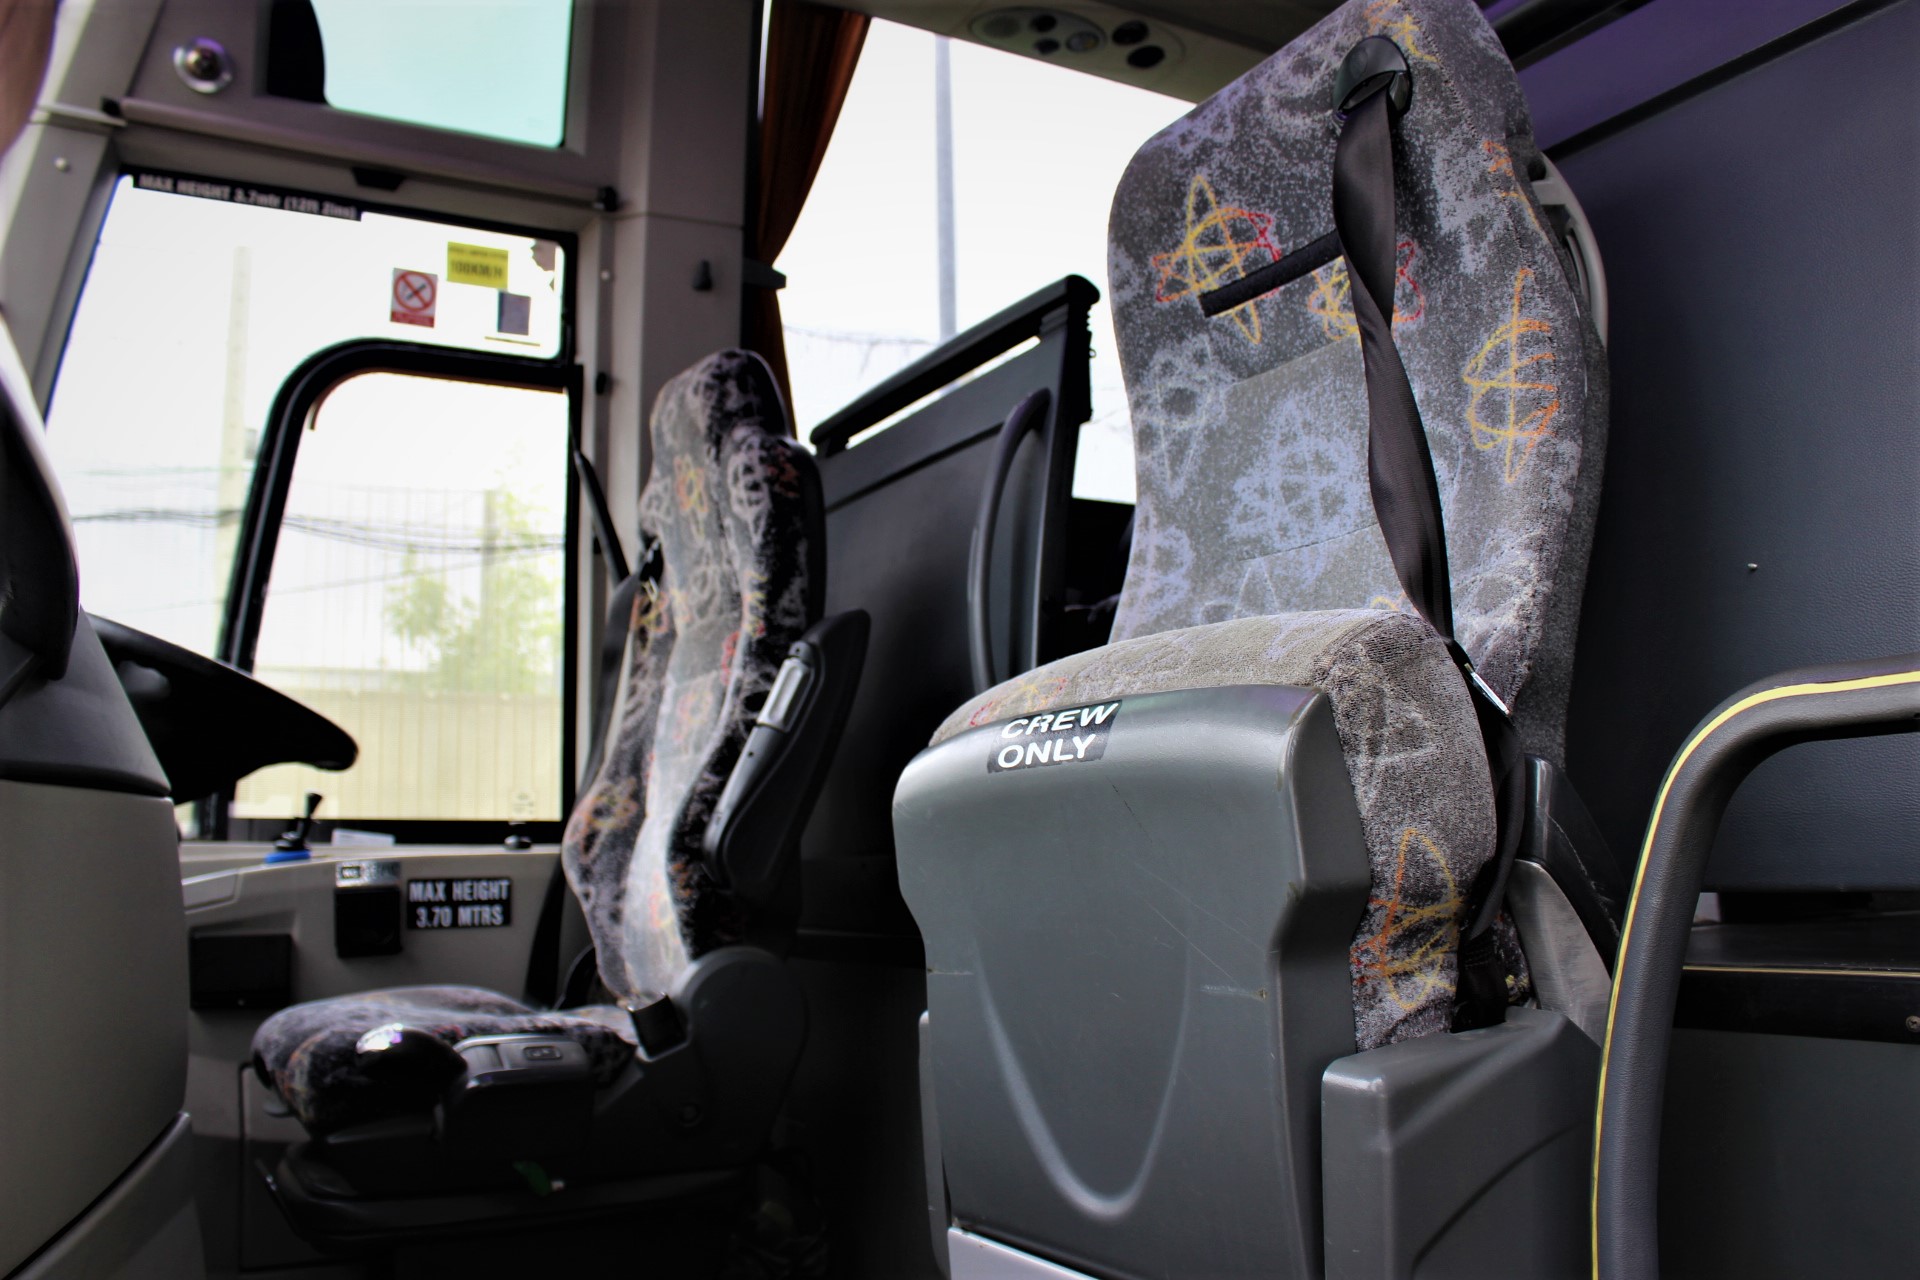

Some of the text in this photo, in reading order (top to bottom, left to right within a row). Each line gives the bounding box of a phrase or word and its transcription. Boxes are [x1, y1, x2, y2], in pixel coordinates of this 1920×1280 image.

[138, 173, 174, 193] MAX
[176, 179, 231, 201] HEIGHT
[1001, 702, 1119, 739] CREW
[997, 733, 1096, 769] ONLY
[409, 879, 510, 902] MAX HEIGHT
[416, 904, 504, 928] 3.70 MTRS
